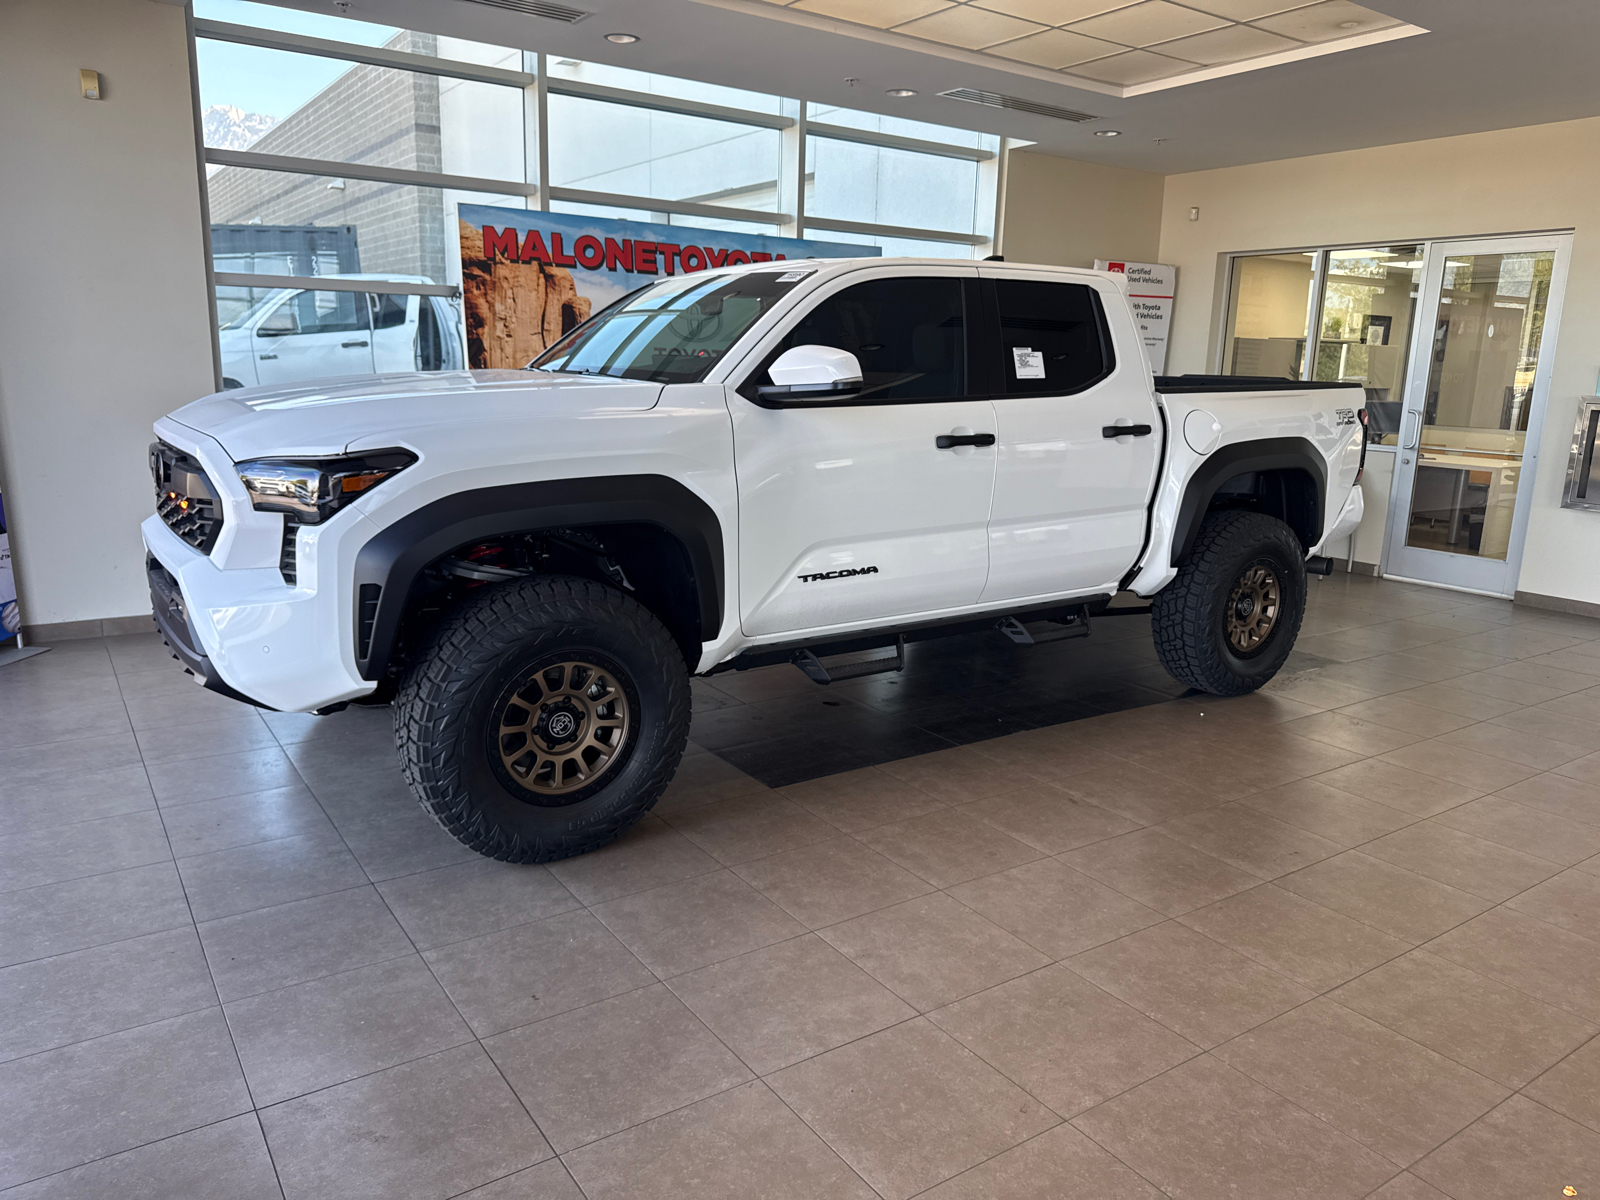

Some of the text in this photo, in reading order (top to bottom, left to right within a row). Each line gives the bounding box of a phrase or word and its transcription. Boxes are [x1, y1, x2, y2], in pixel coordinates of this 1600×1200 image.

[482, 225, 787, 275] MALONETOYO
[1128, 267, 1151, 275] Certified
[1127, 275, 1163, 284] Used Vehicles
[1133, 302, 1161, 312] ith Toyota
[1140, 312, 1163, 320] Vehicles
[797, 566, 879, 583] TACOMA
